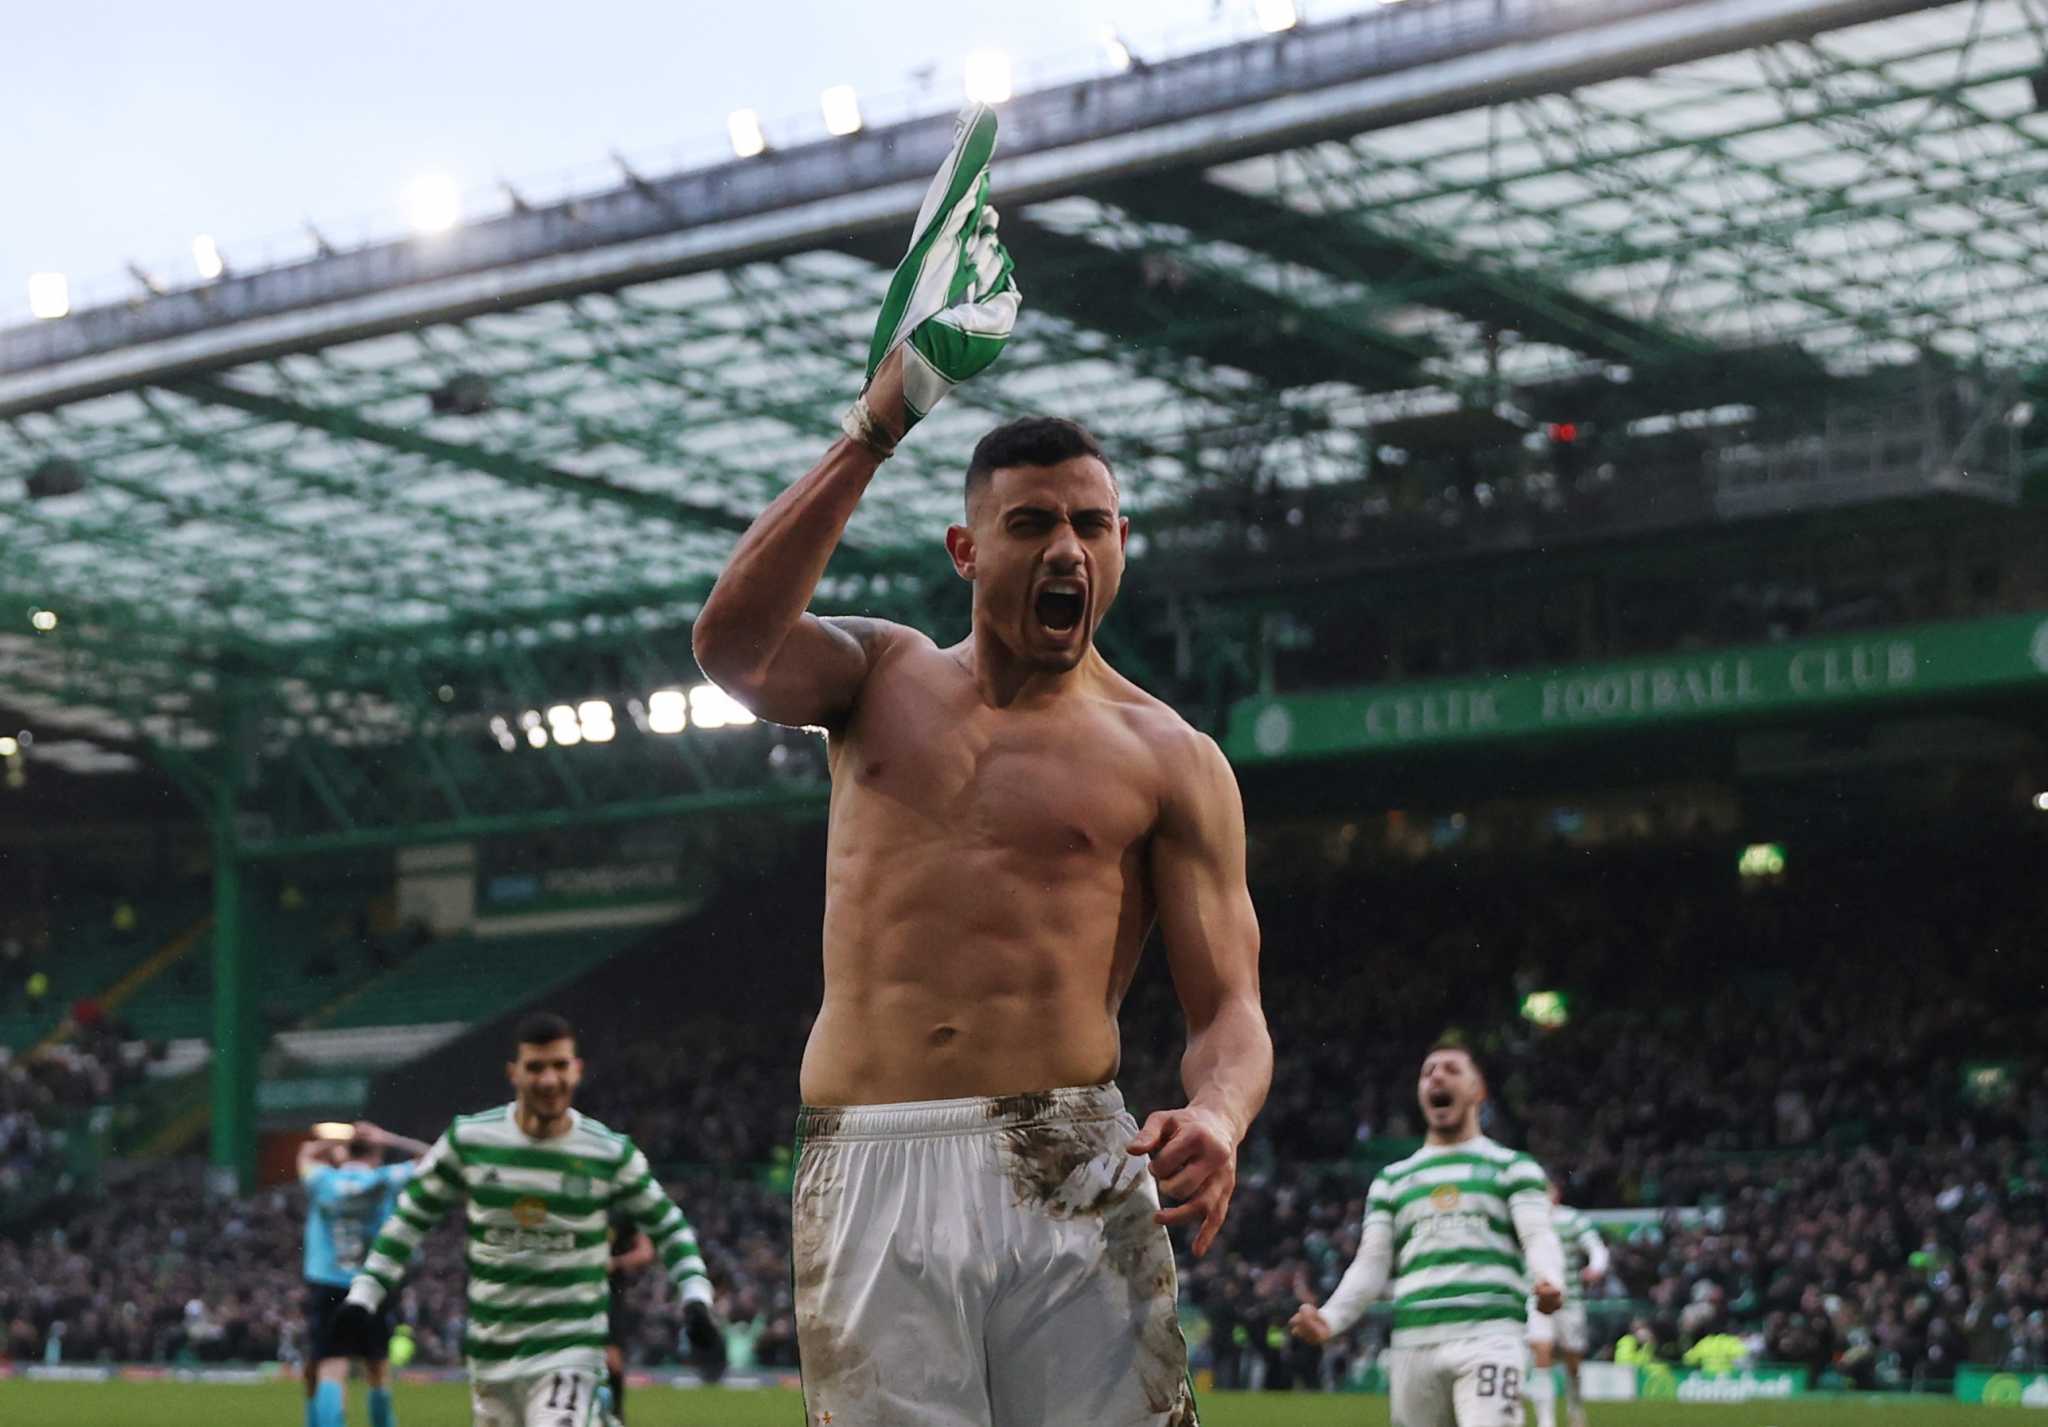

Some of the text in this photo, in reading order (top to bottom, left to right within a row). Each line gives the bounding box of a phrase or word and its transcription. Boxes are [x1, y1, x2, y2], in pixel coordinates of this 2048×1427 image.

[1364, 641, 1917, 737] CELTIC FOOTBALL CLUB
[546, 1373, 581, 1411] 11
[1476, 1364, 1520, 1400] 88
